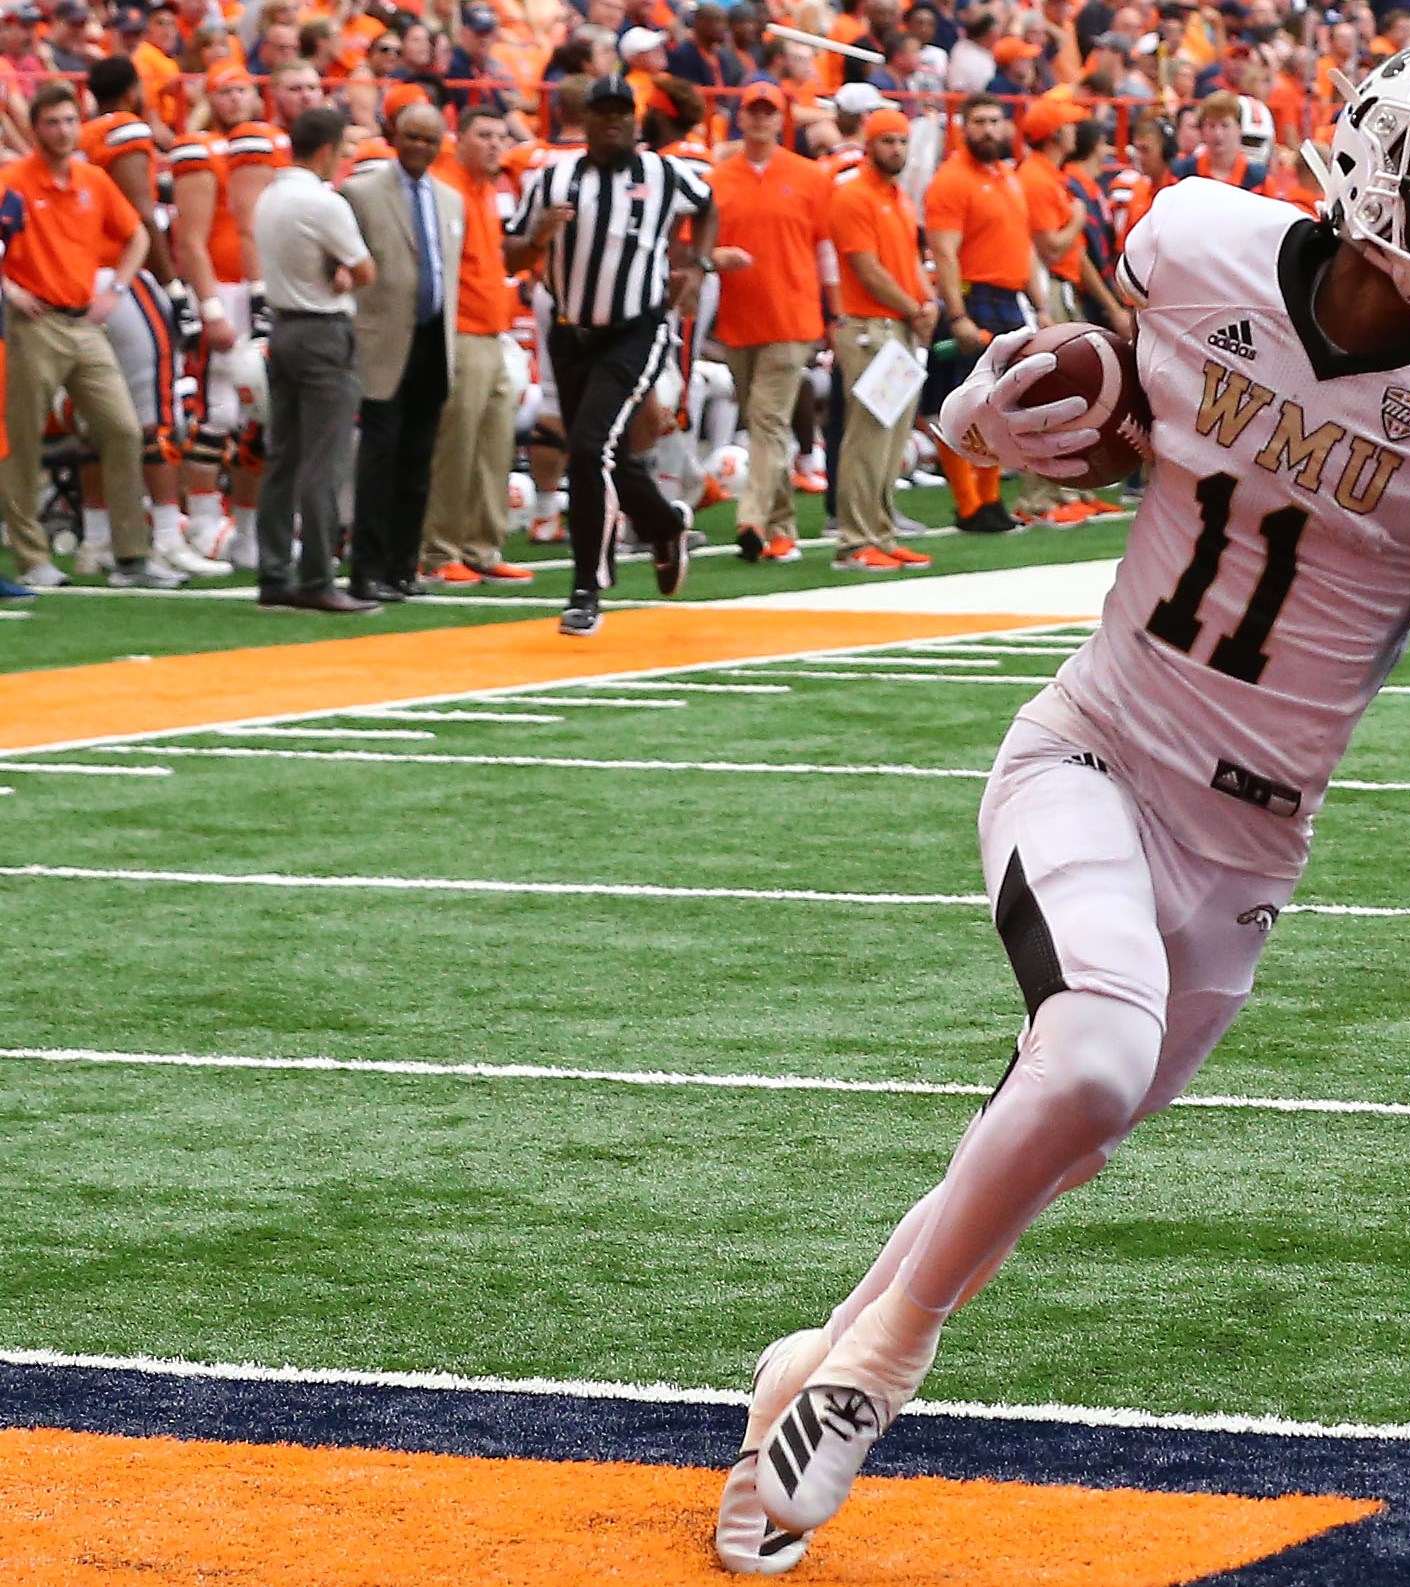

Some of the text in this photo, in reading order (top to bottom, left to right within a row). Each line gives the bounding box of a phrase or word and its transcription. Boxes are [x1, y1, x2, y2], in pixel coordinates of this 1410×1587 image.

[1207, 334, 1257, 360] adidas
[1195, 359, 1404, 515] WMU
[1145, 471, 1310, 686] 11
